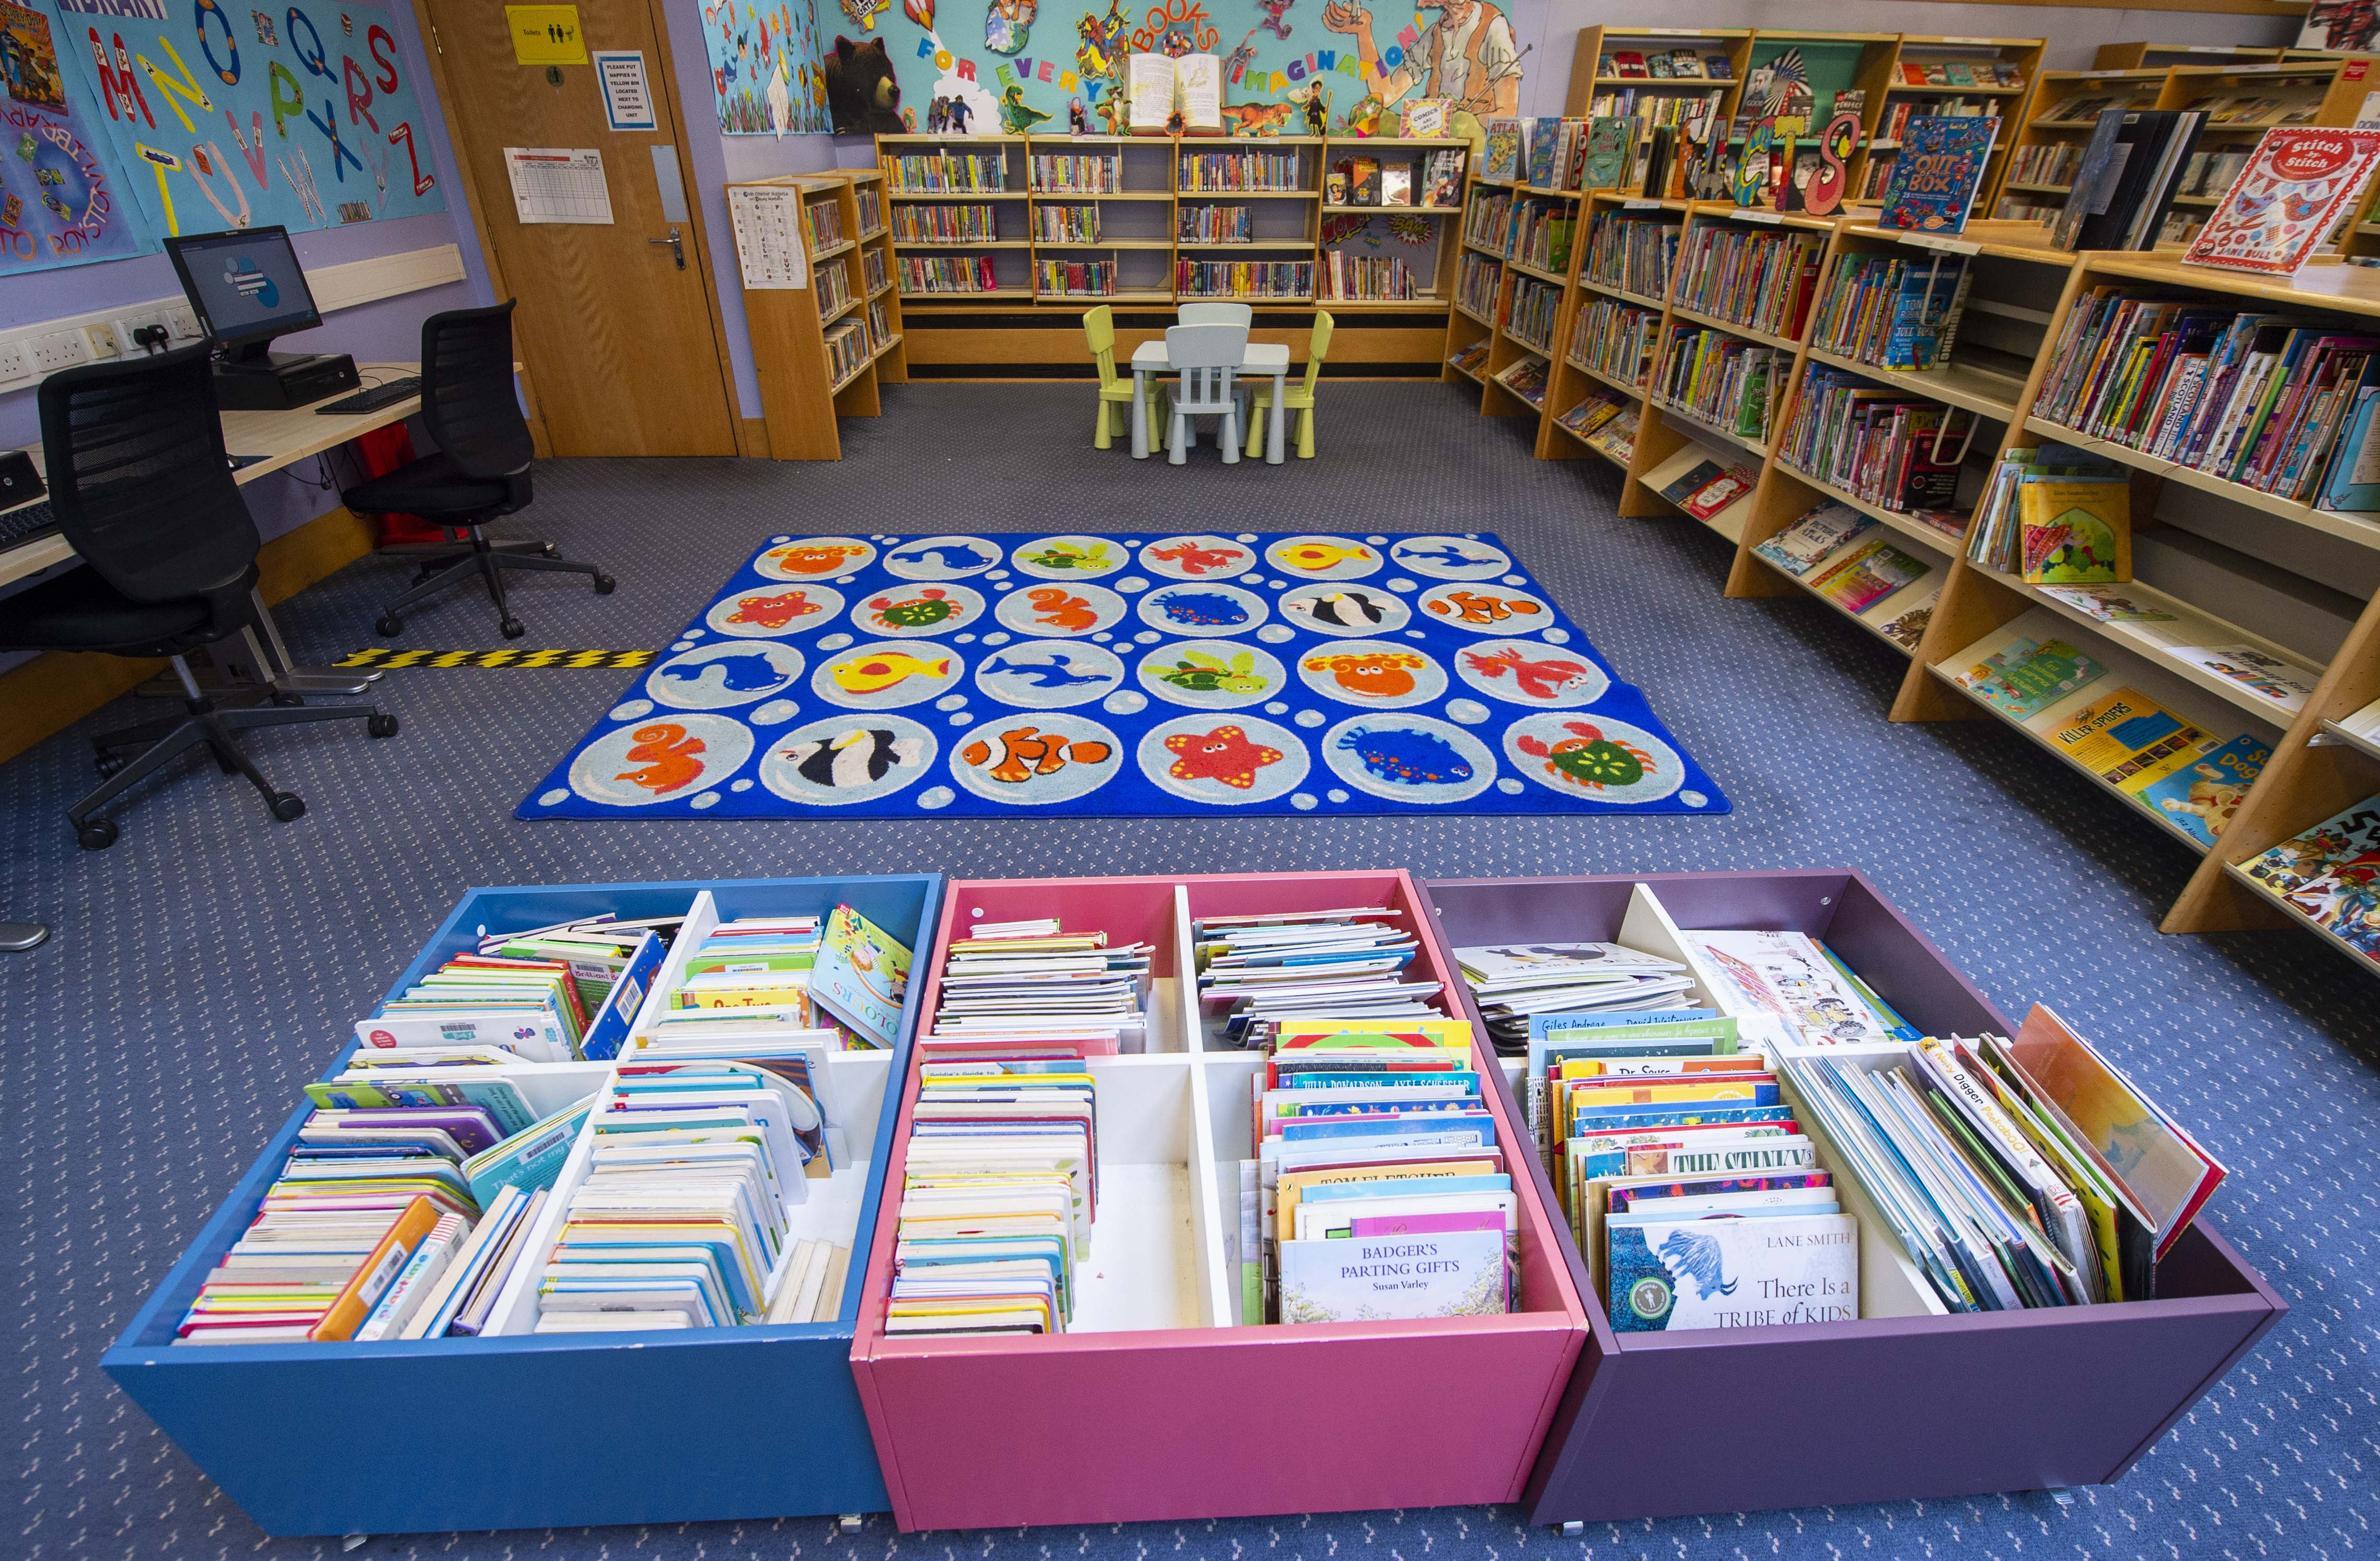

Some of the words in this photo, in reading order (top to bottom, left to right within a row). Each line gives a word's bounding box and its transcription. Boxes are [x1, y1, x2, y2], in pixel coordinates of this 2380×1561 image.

[1132, 0, 1219, 52] BOOKS
[194, 0, 241, 85] O
[286, 7, 338, 84] Q
[917, 38, 976, 83] FOR
[996, 58, 1102, 102] EVERY
[1231, 13, 1425, 95] IMAGINATION!
[368, 24, 398, 94] S
[88, 27, 156, 130] M
[136, 36, 213, 133] N
[269, 61, 304, 140] P
[342, 55, 379, 133] R
[1414, 108, 1438, 121] COMICS
[225, 110, 268, 190] V
[307, 98, 363, 183] X
[2292, 140, 2344, 155] Stitch
[360, 136, 388, 210] Y
[389, 122, 434, 197] Z
[1915, 154, 1960, 174] OUT
[2285, 157, 2328, 168] Stitch
[136, 142, 182, 236] T
[187, 141, 251, 228] U
[275, 144, 327, 225] W
[1908, 174, 1950, 192] BOX
[47, 173, 110, 258] ROYSTON
[1392, 217, 1430, 237] BAM!
[2216, 247, 2244, 256] JANE
[2245, 250, 2270, 259] BULL
[1905, 300, 1924, 311] TON
[2165, 378, 2188, 426] SCOTLAND
[2174, 380, 2199, 428] SCOTLAND
[1799, 528, 1827, 544] ATLAS
[2058, 724, 2095, 745] KILLER
[2093, 702, 2132, 728] SPIDERS
[2217, 753, 2260, 779] Dog
[2175, 817, 2188, 827] Jez
[575, 970, 609, 980] Brilliant
[833, 982, 897, 1036] OLOURS
[1542, 1019, 1567, 1032] Giles
[1331, 1080, 1382, 1088] DONALDSON
[1420, 1080, 1470, 1091] SCHEFFLER
[1954, 1072, 1984, 1106] Digger
[492, 1168, 525, 1190] That's
[527, 1156, 546, 1171] not
[547, 1145, 565, 1158] my
[1674, 1153, 1719, 1173] THE
[2046, 1181, 2063, 1196] DK
[1362, 1243, 1438, 1259] BADGER'S
[1767, 1235, 1803, 1248] LANE
[1807, 1232, 1852, 1246] SMITH
[1341, 1262, 1410, 1278] PARTING
[1416, 1260, 1460, 1273] GIFTS
[1373, 1280, 1399, 1290] Susan
[1401, 1279, 1428, 1290] Varley
[1638, 1284, 1658, 1292] Winner
[1758, 1277, 1815, 1299] There
[1822, 1277, 1836, 1294] Is
[1840, 1281, 1850, 1294] a
[1714, 1310, 1775, 1328] TRIBE
[1782, 1302, 1803, 1324] of
[1804, 1304, 1852, 1323] KIDS
